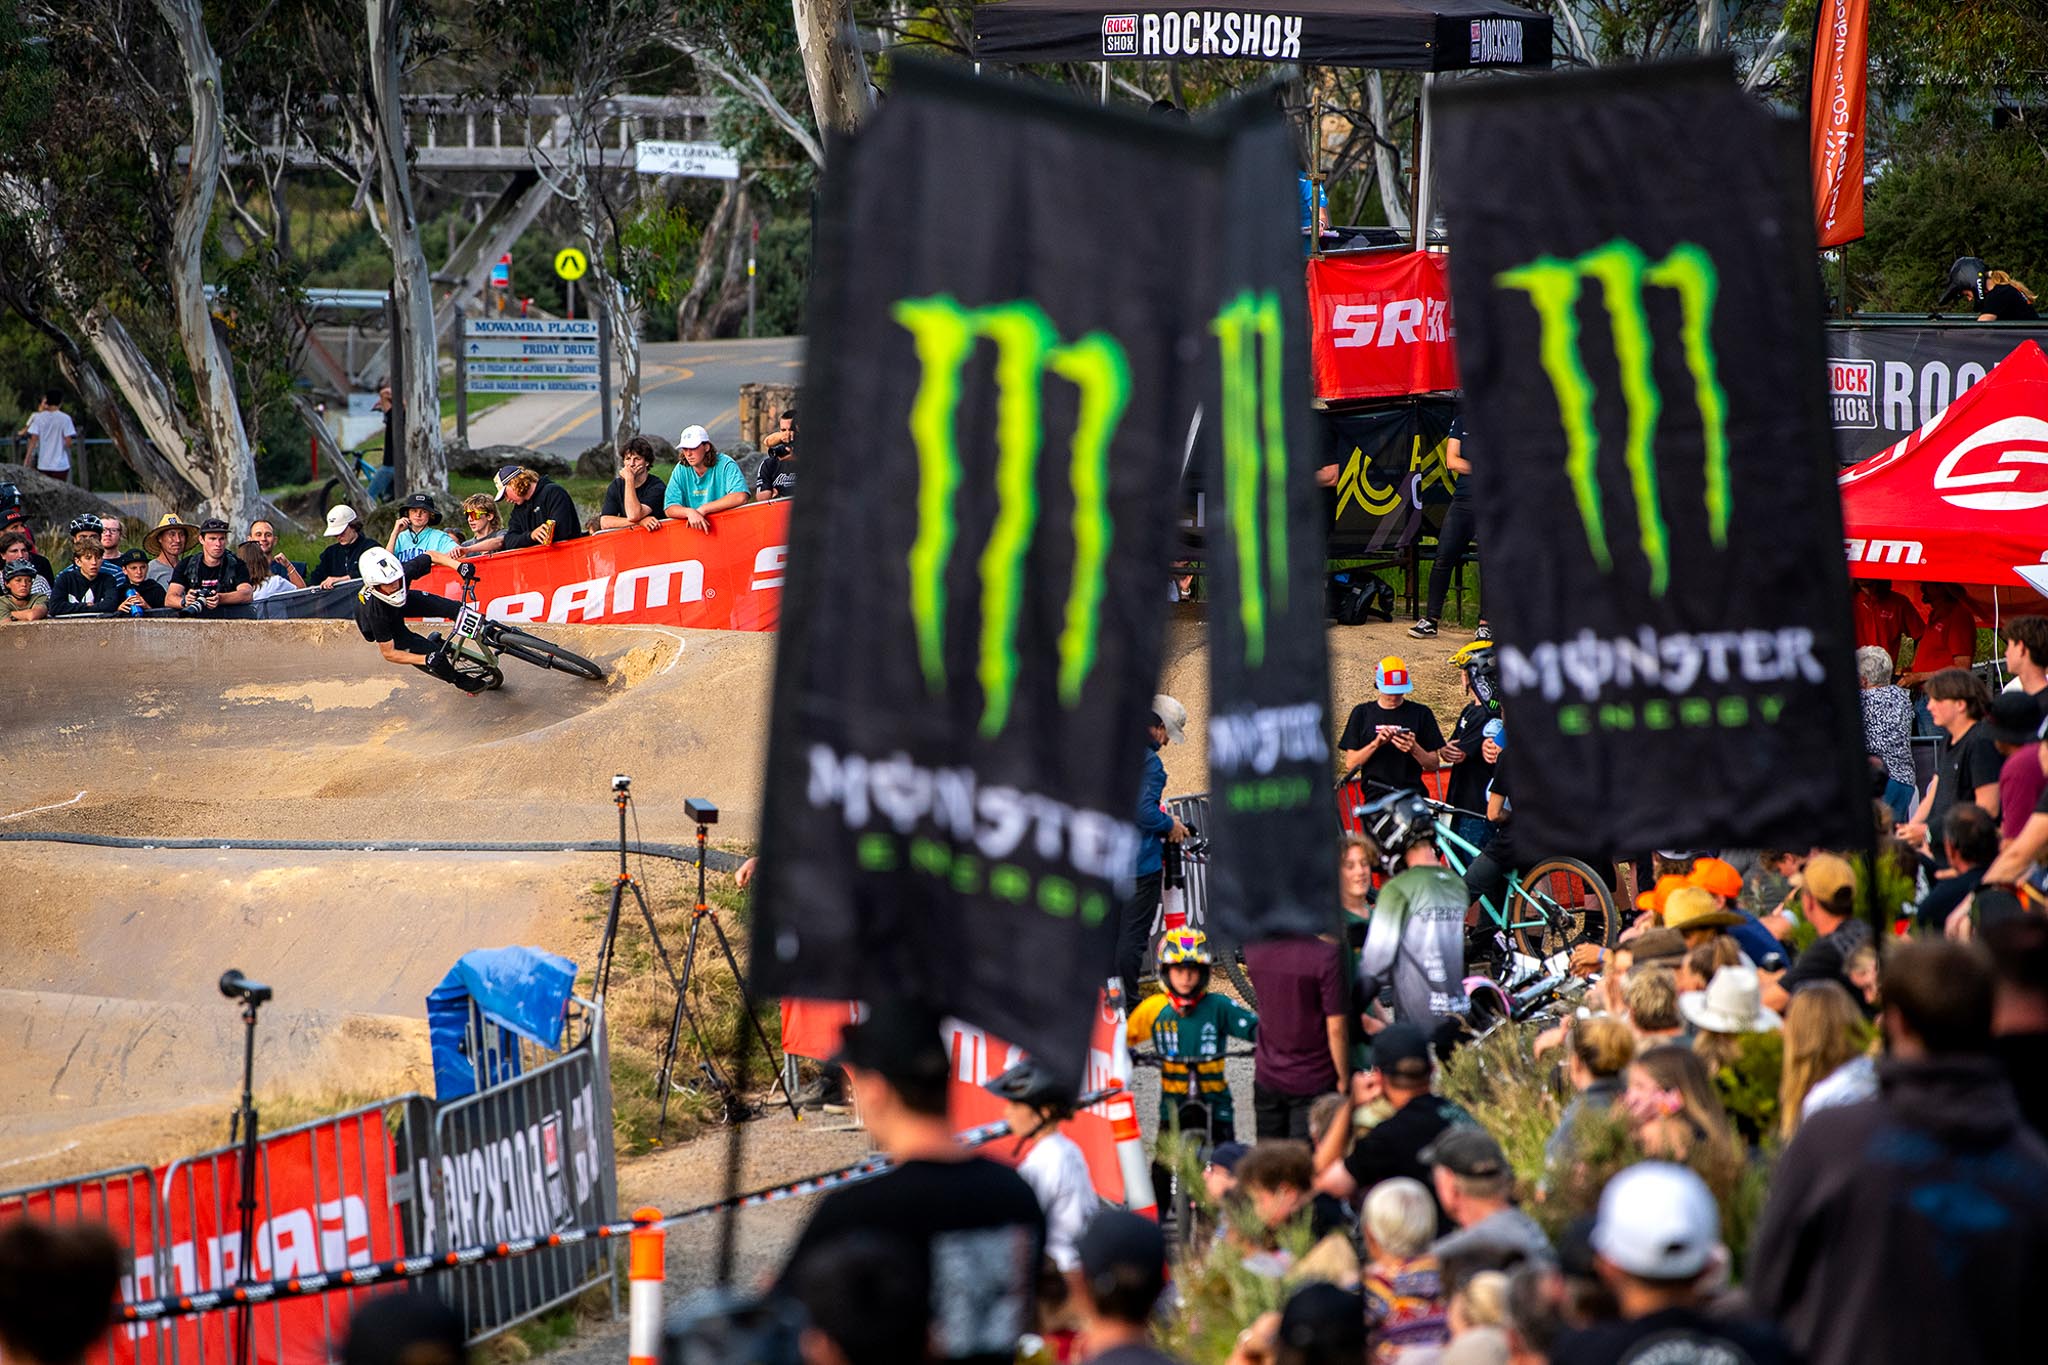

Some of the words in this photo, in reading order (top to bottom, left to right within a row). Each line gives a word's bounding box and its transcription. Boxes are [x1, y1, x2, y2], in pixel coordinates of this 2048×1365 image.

[1107, 18, 1134, 33] ROCK
[1142, 11, 1303, 58] ROCKSHOX
[1107, 35, 1134, 51] SHOX
[475, 322, 543, 332] MOWAMBA
[549, 323, 589, 333] PLACE
[523, 344, 559, 354] FRIDAY
[564, 344, 596, 354] DRIVE
[1834, 396, 1870, 421] HOX
[1844, 538, 1923, 565] AM
[468, 559, 705, 624] RAM
[461, 612, 479, 637] 601
[1499, 625, 1826, 701] MONSTER
[808, 743, 1142, 898] MONSTER
